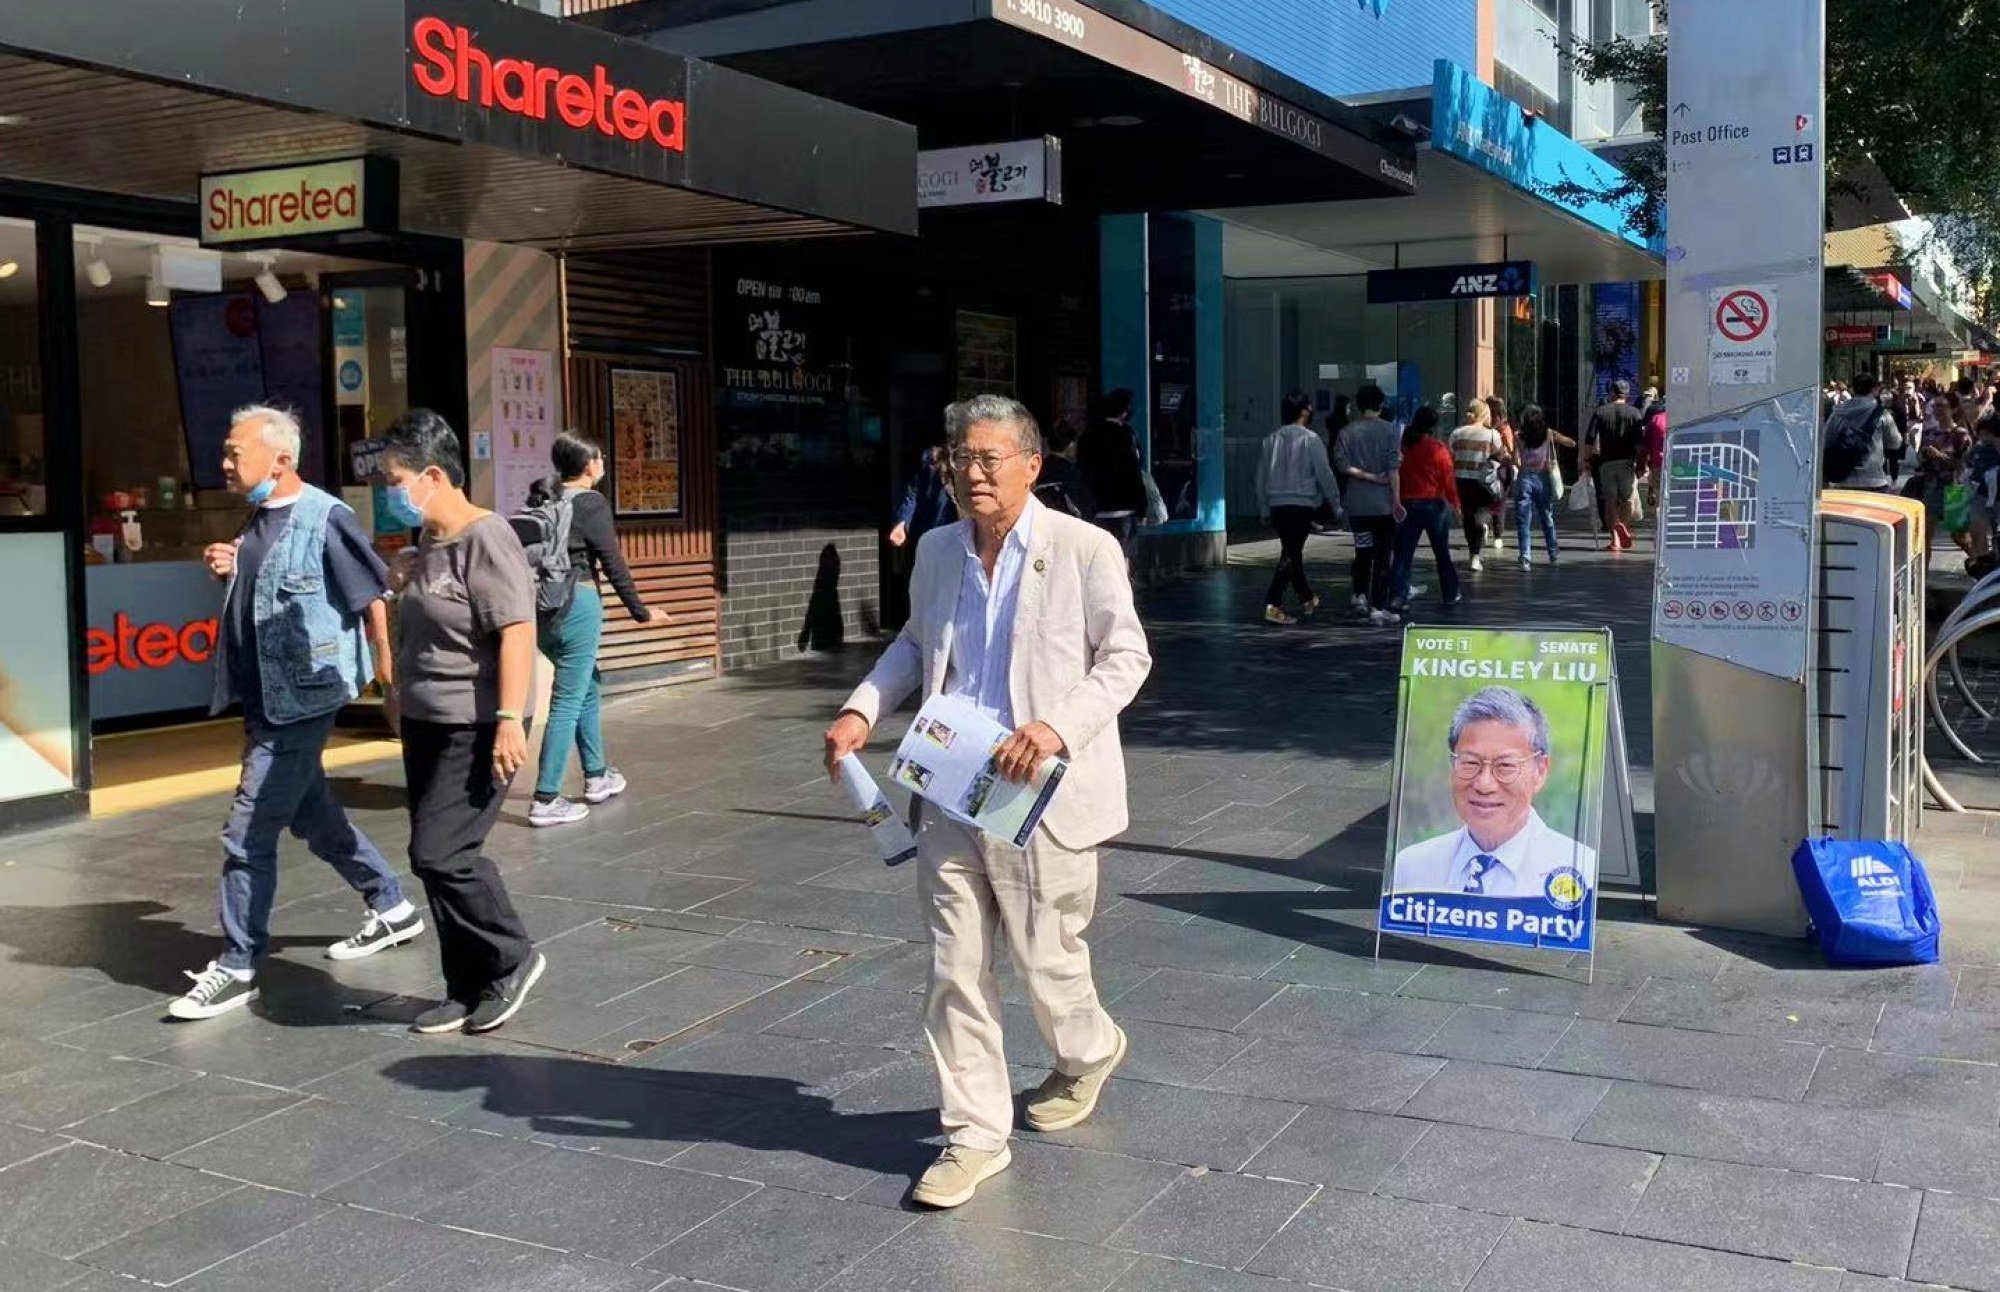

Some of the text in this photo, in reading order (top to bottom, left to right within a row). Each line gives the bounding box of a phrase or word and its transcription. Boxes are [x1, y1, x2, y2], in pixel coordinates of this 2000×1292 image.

[1020, 0, 1051, 24] 9410
[1054, 7, 1085, 39] 3900
[413, 16, 685, 151] Sharetea
[1223, 78, 1322, 148] THE BULGOGI
[1672, 124, 1749, 145] Post Office
[209, 180, 356, 231] Sharetea
[737, 279, 767, 297] OPEN
[1450, 274, 1498, 294] ANZ
[86, 611, 219, 675] etea
[1416, 638, 1453, 650] VOTE
[1540, 641, 1599, 654] SENATE
[1413, 657, 1597, 682] KINGSLEY LIU
[1858, 876, 1900, 889] ALDI
[1389, 897, 1584, 943] Citizens Party
